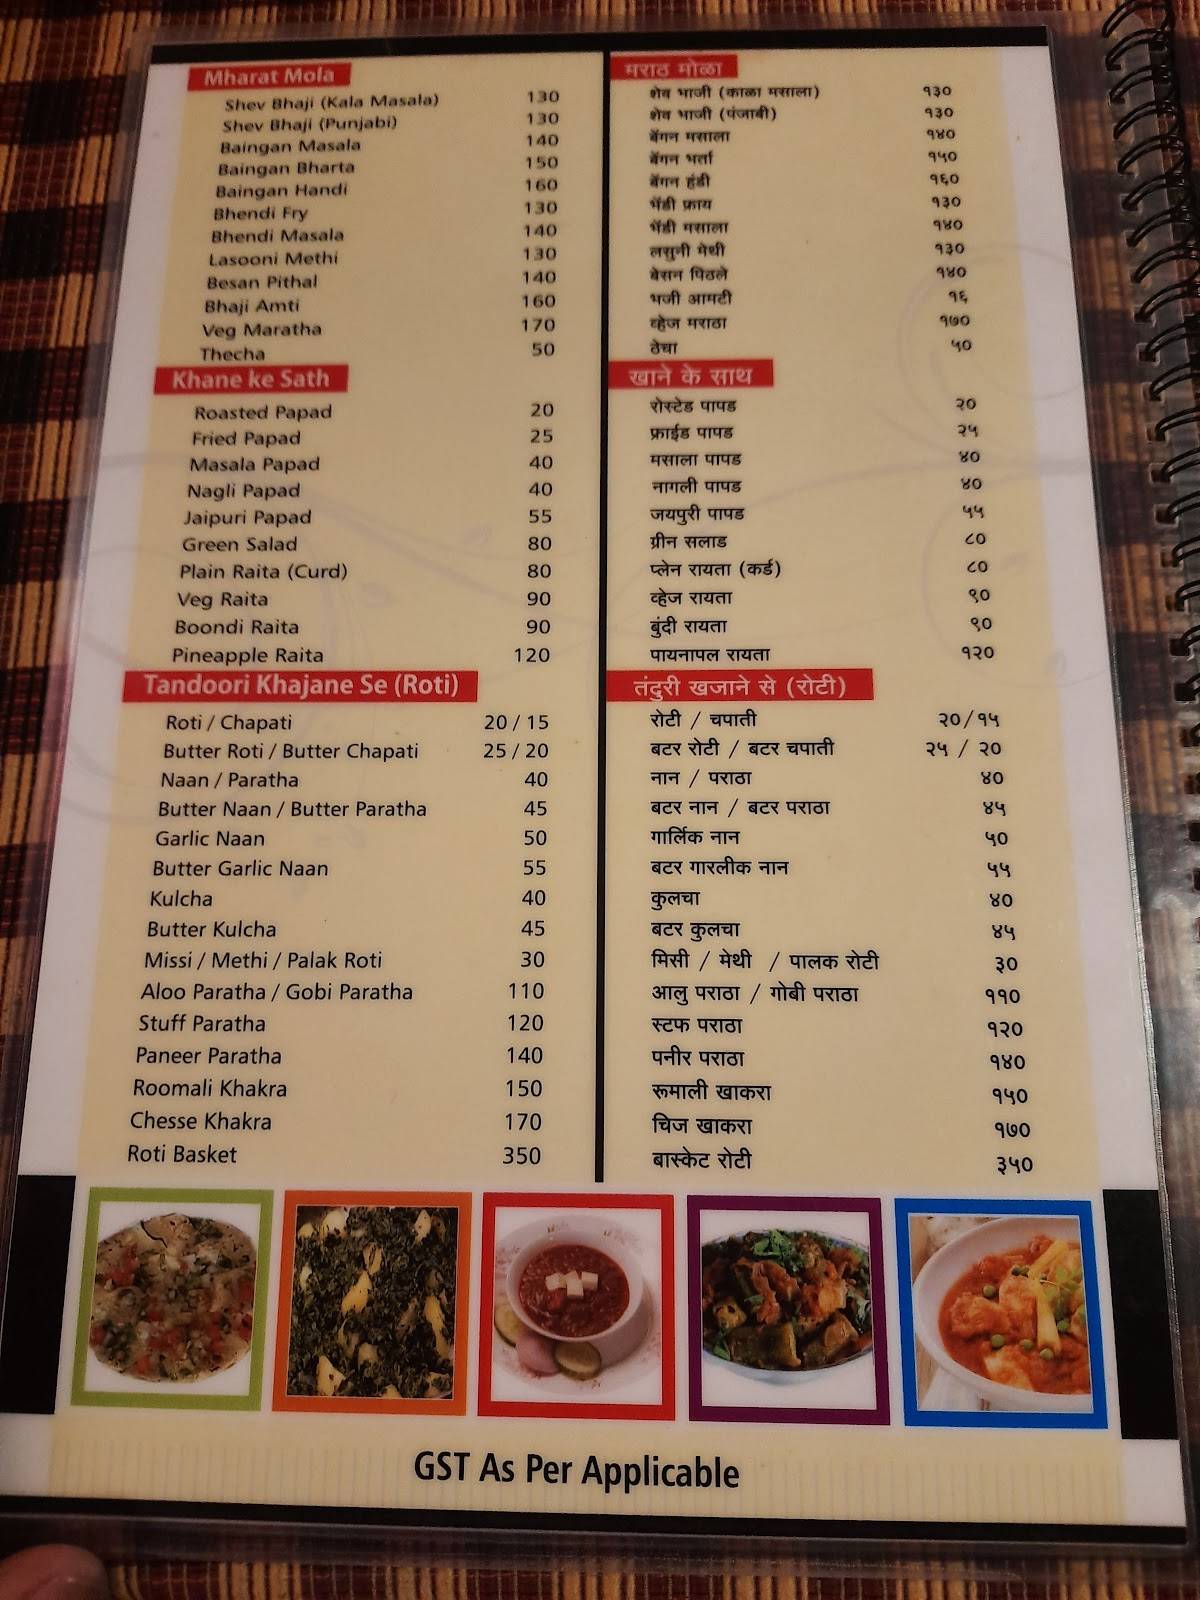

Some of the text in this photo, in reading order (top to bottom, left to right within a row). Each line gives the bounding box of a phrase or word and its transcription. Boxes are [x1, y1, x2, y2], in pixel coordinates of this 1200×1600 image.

[205, 66, 334, 86] Mharat Mola
[225, 93, 439, 112] Shev Bhaji (Kala Masala)
[528, 90, 560, 103] 130
[528, 112, 559, 125] 130
[924, 107, 954, 119] १३०
[223, 116, 397, 134] Shev Bhaji (Punjabi)
[214, 206, 308, 223] Bhendi Fry
[525, 201, 558, 214] 130
[209, 251, 338, 267] Lasooni Methi
[524, 247, 557, 260] 130
[523, 294, 556, 308] 160
[948, 290, 968, 304] १६
[205, 299, 299, 316] Bhaji Amti
[202, 322, 322, 340] Veg Maratha
[522, 318, 555, 332] 170
[201, 347, 265, 361] Thecha
[532, 342, 555, 356] 50
[173, 368, 329, 389] Khane ke Sath
[531, 403, 554, 417] 20
[650, 396, 737, 413] रोस्टेड पापड
[956, 398, 977, 411] २०
[195, 404, 332, 423] Roasted Papad
[193, 430, 301, 448] Fried Papad
[530, 429, 553, 443] 25
[190, 456, 320, 475] Masala Papad
[529, 455, 553, 470] 40
[650, 453, 742, 467] मसाला पापड
[959, 451, 980, 463] ४०
[188, 482, 300, 502] Nagli Papad
[529, 482, 553, 496] 40
[184, 509, 312, 528] Jaipuri Papad
[529, 509, 552, 524] 55
[182, 536, 297, 552] Green Salad
[528, 536, 552, 551] 80
[650, 531, 728, 549] ग्रीन सलाड
[965, 533, 986, 545] ८०
[180, 563, 347, 581] Plain Raita (Curd)
[527, 564, 551, 578] 80
[650, 558, 781, 579] प्लेन रायता (कर्ड)
[967, 560, 988, 573] ८०
[177, 591, 268, 611] Veg Raita
[527, 592, 551, 606] 90
[650, 615, 728, 639] बुंदी रायता
[970, 617, 992, 632] ९०
[173, 647, 323, 666] Pineapple Raita
[515, 648, 550, 663] 120
[144, 673, 458, 700] Tandoori Khajane Se (Roti)
[633, 674, 846, 700] तंदुरी खजाने से (रोटी)
[156, 830, 264, 846] Garlic Naan
[524, 830, 547, 846] 50
[650, 826, 741, 845] गार्लिक नान
[985, 831, 1008, 847] ५०
[153, 859, 328, 876] Butter Garlic Naan
[524, 860, 546, 876] 55
[650, 855, 789, 875] बटर गारलीक नान
[987, 862, 1011, 878] ५५
[150, 889, 212, 907] Kulcha
[522, 890, 546, 906] 40
[650, 891, 701, 911] कुलचा
[989, 893, 1013, 907] ४०
[147, 920, 276, 937] Butter Kulcha
[521, 920, 545, 936] 45
[651, 922, 741, 942] बटर कुलचा
[992, 924, 1016, 941] ४५
[139, 1014, 265, 1032] Stuff Paratha
[508, 1014, 544, 1031] 120
[651, 1018, 743, 1034] स्टफ पराठा
[988, 1021, 1023, 1038] १२०
[136, 1046, 281, 1064] Paneer Paratha
[507, 1047, 543, 1064] 140
[651, 1045, 745, 1067] पनीर पराठा
[990, 1054, 1025, 1071] १४०
[133, 1078, 287, 1097] Roomali Khakra
[506, 1079, 542, 1097] 150
[652, 1078, 772, 1101] रूमाली खाकरा
[992, 1088, 1028, 1105] १५०
[130, 1110, 271, 1130] Chesse Khakra
[506, 1113, 541, 1131] 170
[652, 1112, 753, 1135] चिज खाकरा
[995, 1122, 1030, 1139] १७०
[128, 1144, 237, 1163] Roti Basket
[503, 1147, 541, 1165] 350
[652, 1146, 752, 1169] बास्केट रोटी
[997, 1156, 1033, 1175] ३५०
[414, 1451, 739, 1494] GST As Per Applicable
